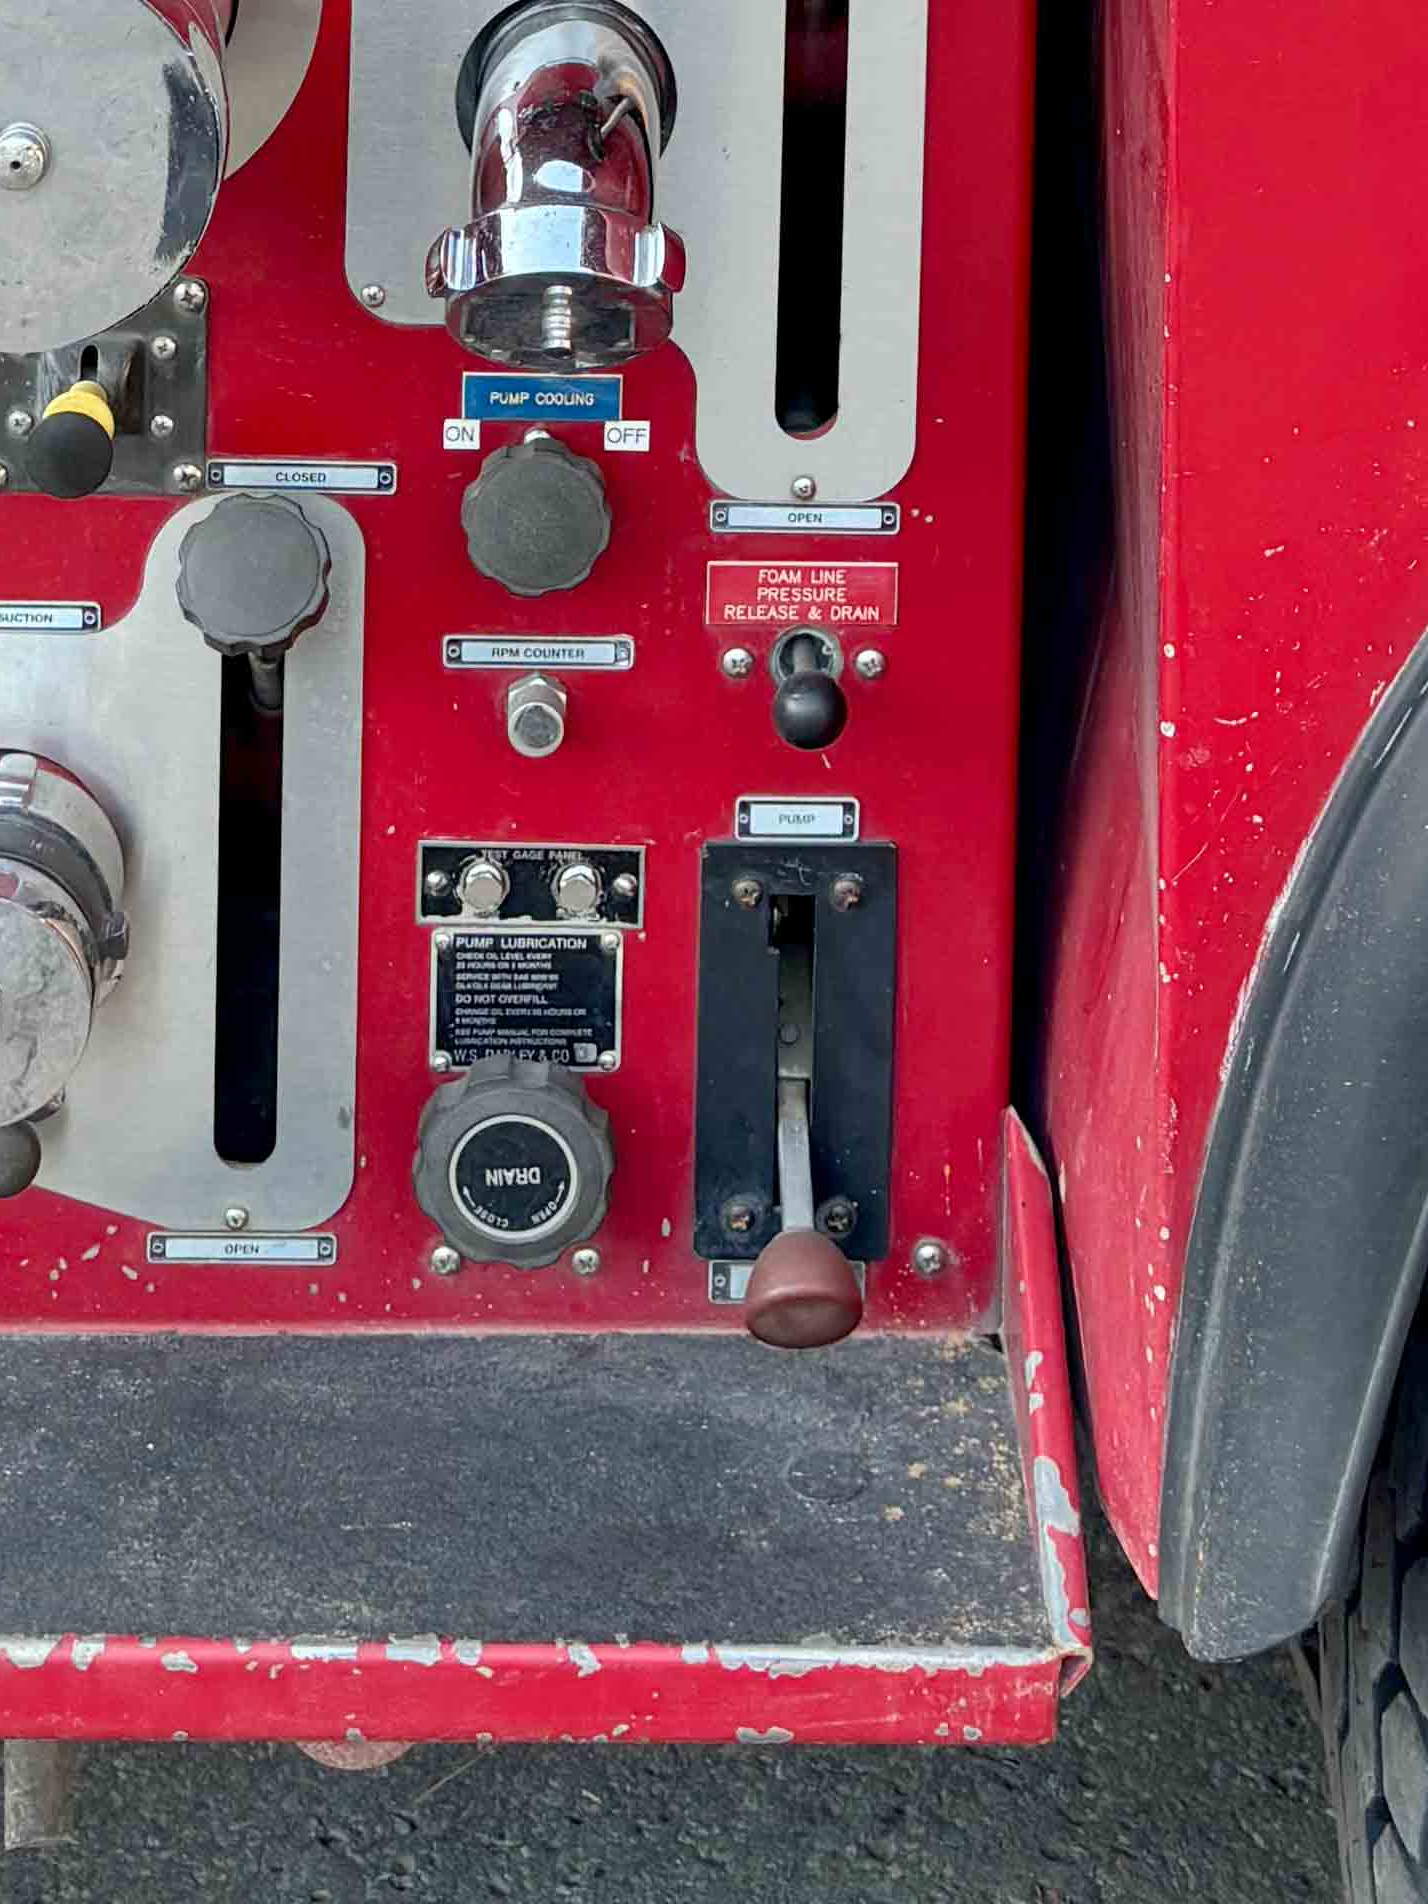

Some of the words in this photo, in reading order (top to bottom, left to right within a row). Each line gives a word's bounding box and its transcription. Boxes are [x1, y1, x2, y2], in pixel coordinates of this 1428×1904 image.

[489, 391, 529, 405] PUMP
[535, 392, 595, 406] COOLING
[445, 426, 475, 442] ON
[606, 428, 647, 444] OFF
[275, 472, 327, 483] CLOSED
[788, 512, 822, 523] OPEN
[758, 569, 801, 584] FOAM
[811, 570, 847, 584] LINE
[756, 587, 847, 603] PRESSURE
[724, 605, 799, 620] RELEASE
[808, 605, 822, 620] &
[830, 605, 880, 621] DRAIN
[492, 647, 520, 659] RPM
[523, 648, 586, 659] COUNTER
[778, 813, 816, 825] PUMP
[482, 849, 508, 860] TEST
[513, 850, 544, 860] GAGE
[548, 851, 583, 861] PANEL
[455, 937, 494, 948] PUMP
[500, 937, 587, 949] LUBRICATION
[455, 994, 472, 1004] DO
[474, 994, 496, 1004] NOT
[498, 995, 548, 1005] OVERFILL
[485, 1167, 541, 1186] DRAIN
[475, 1205, 509, 1228] CLOSE
[531, 1201, 557, 1224] OPEN
[224, 1243, 260, 1255] OPEN
